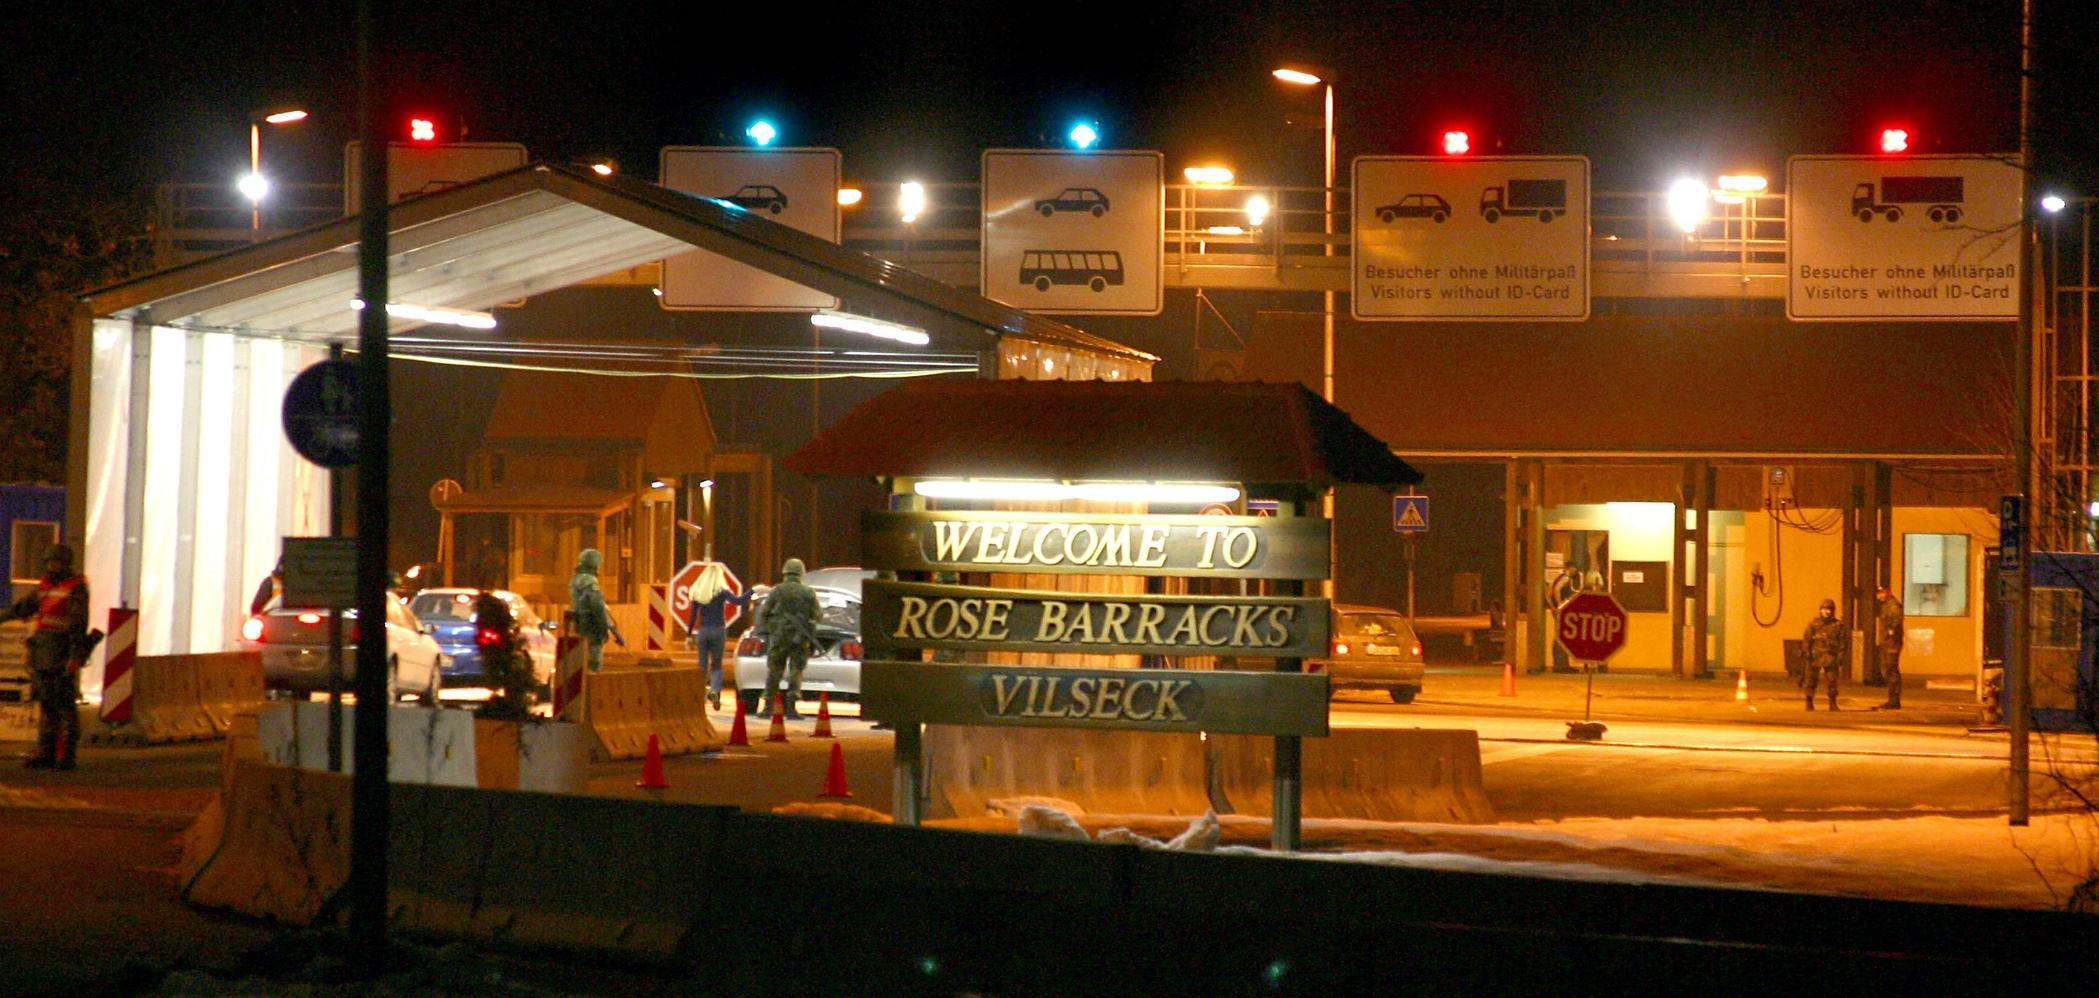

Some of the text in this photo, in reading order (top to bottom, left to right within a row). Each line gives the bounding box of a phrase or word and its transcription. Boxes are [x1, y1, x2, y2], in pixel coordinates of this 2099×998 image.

[1366, 264, 1576, 283] Besucher ohne Militärpaß
[1801, 264, 2016, 283] Besucher ohne Militärpaß
[1371, 285, 1570, 299] Visitors without ID-Card
[1804, 285, 2010, 299] Visitors without ID-Card
[931, 520, 1258, 570] WELCOME TO
[894, 596, 1296, 648] ROSE BARRACKS
[1563, 612, 1622, 642] STOP
[991, 673, 1193, 723] VILSECK
